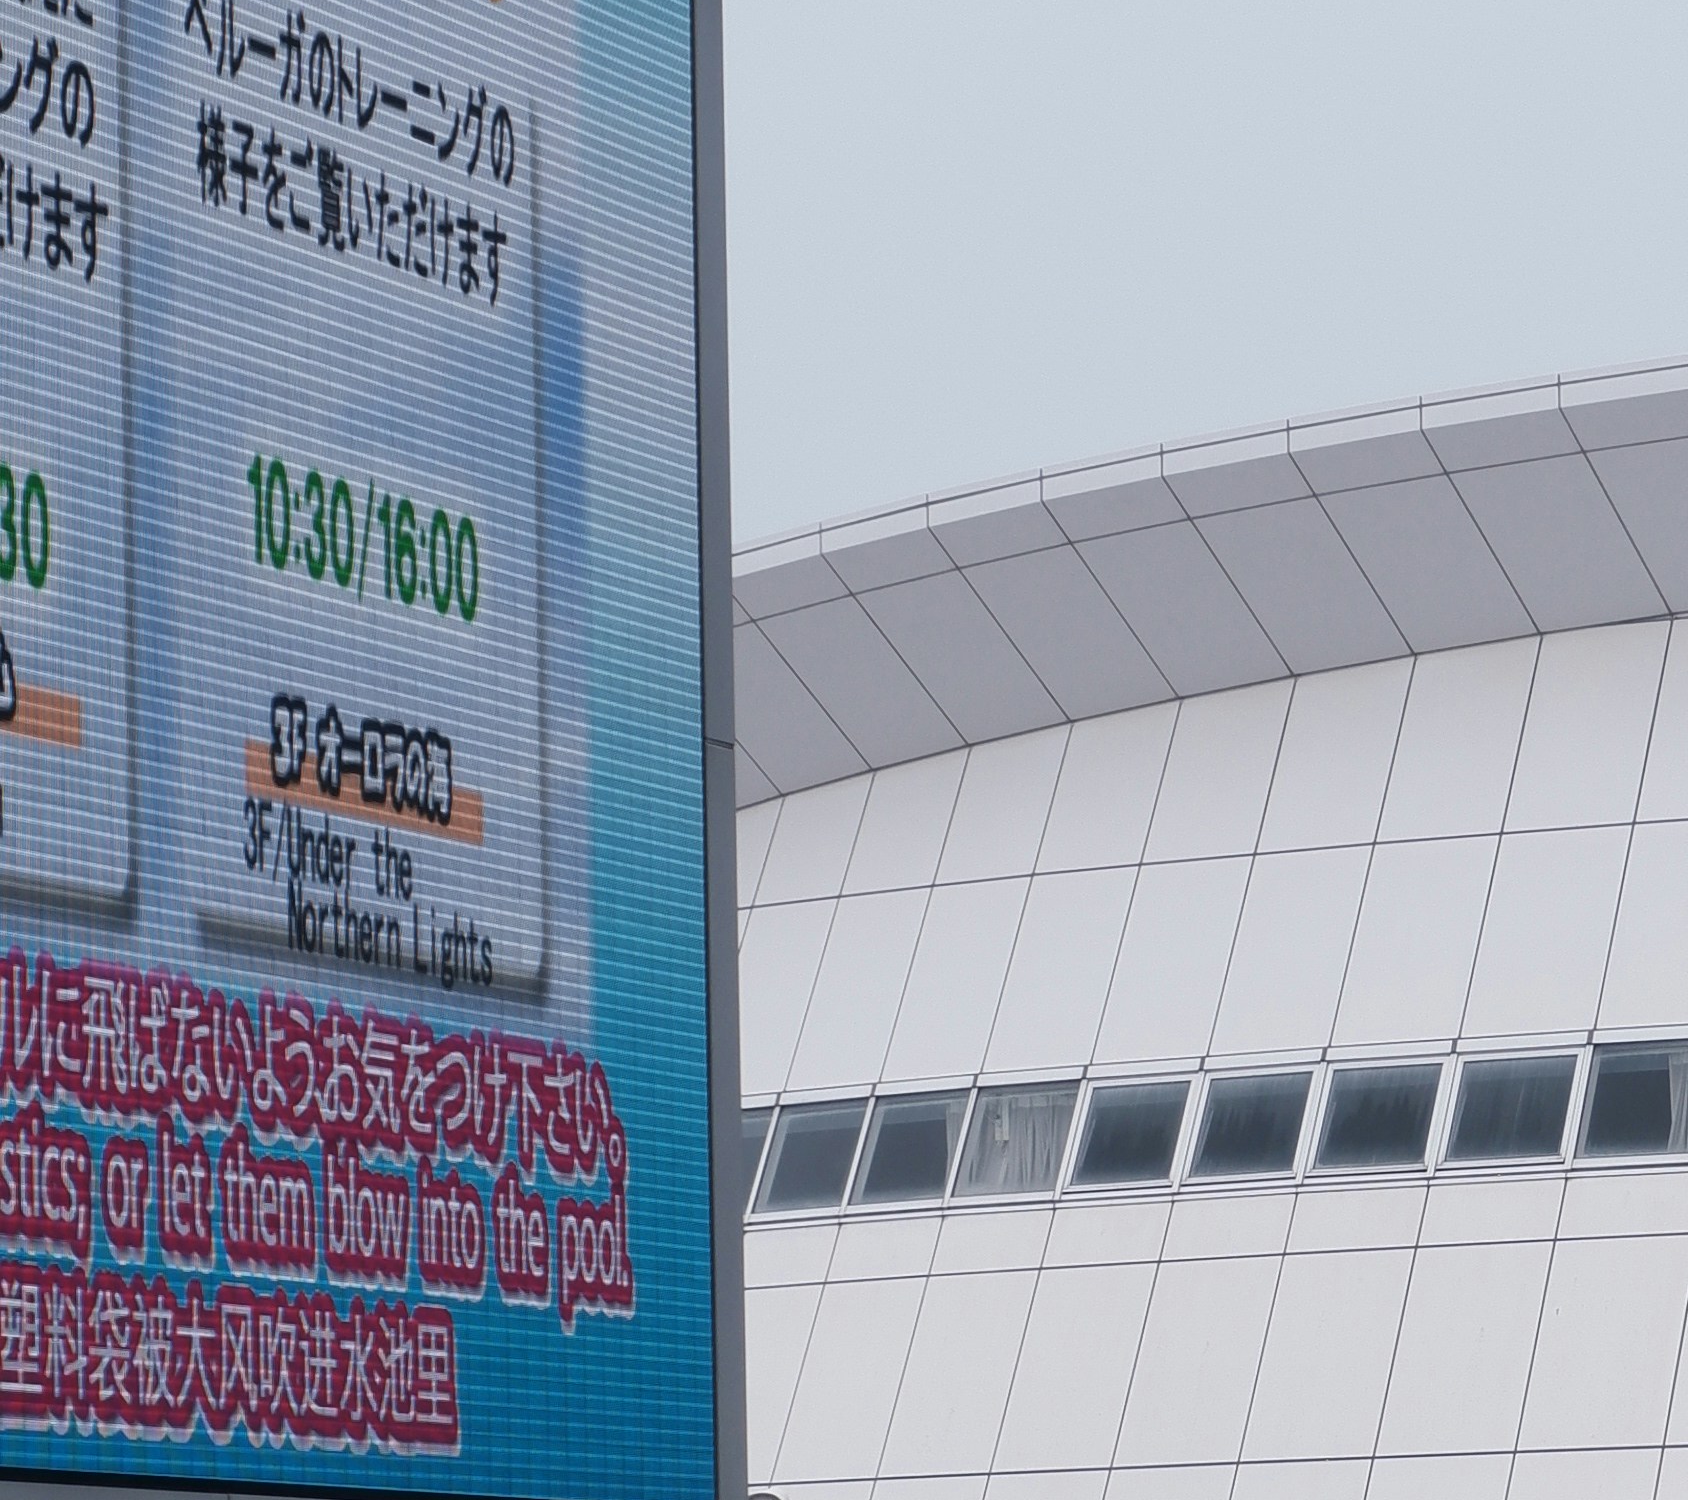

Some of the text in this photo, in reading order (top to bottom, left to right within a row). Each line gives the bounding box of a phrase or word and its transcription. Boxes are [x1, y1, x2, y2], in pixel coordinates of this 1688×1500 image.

[197, 100, 507, 306] 様子をご覧いただけます
[246, 455, 478, 622] 10:30/16:00
[270, 693, 452, 826] 3F オーロラの海
[288, 878, 493, 990] Northern Lights
[371, 823, 412, 900] the
[107, 1153, 144, 1228] or
[162, 1130, 207, 1238] let
[223, 1141, 312, 1250] them
[327, 1153, 406, 1260] blow
[422, 1170, 480, 1268] into
[496, 1178, 546, 1277] the
[562, 1193, 629, 1304] pool.
